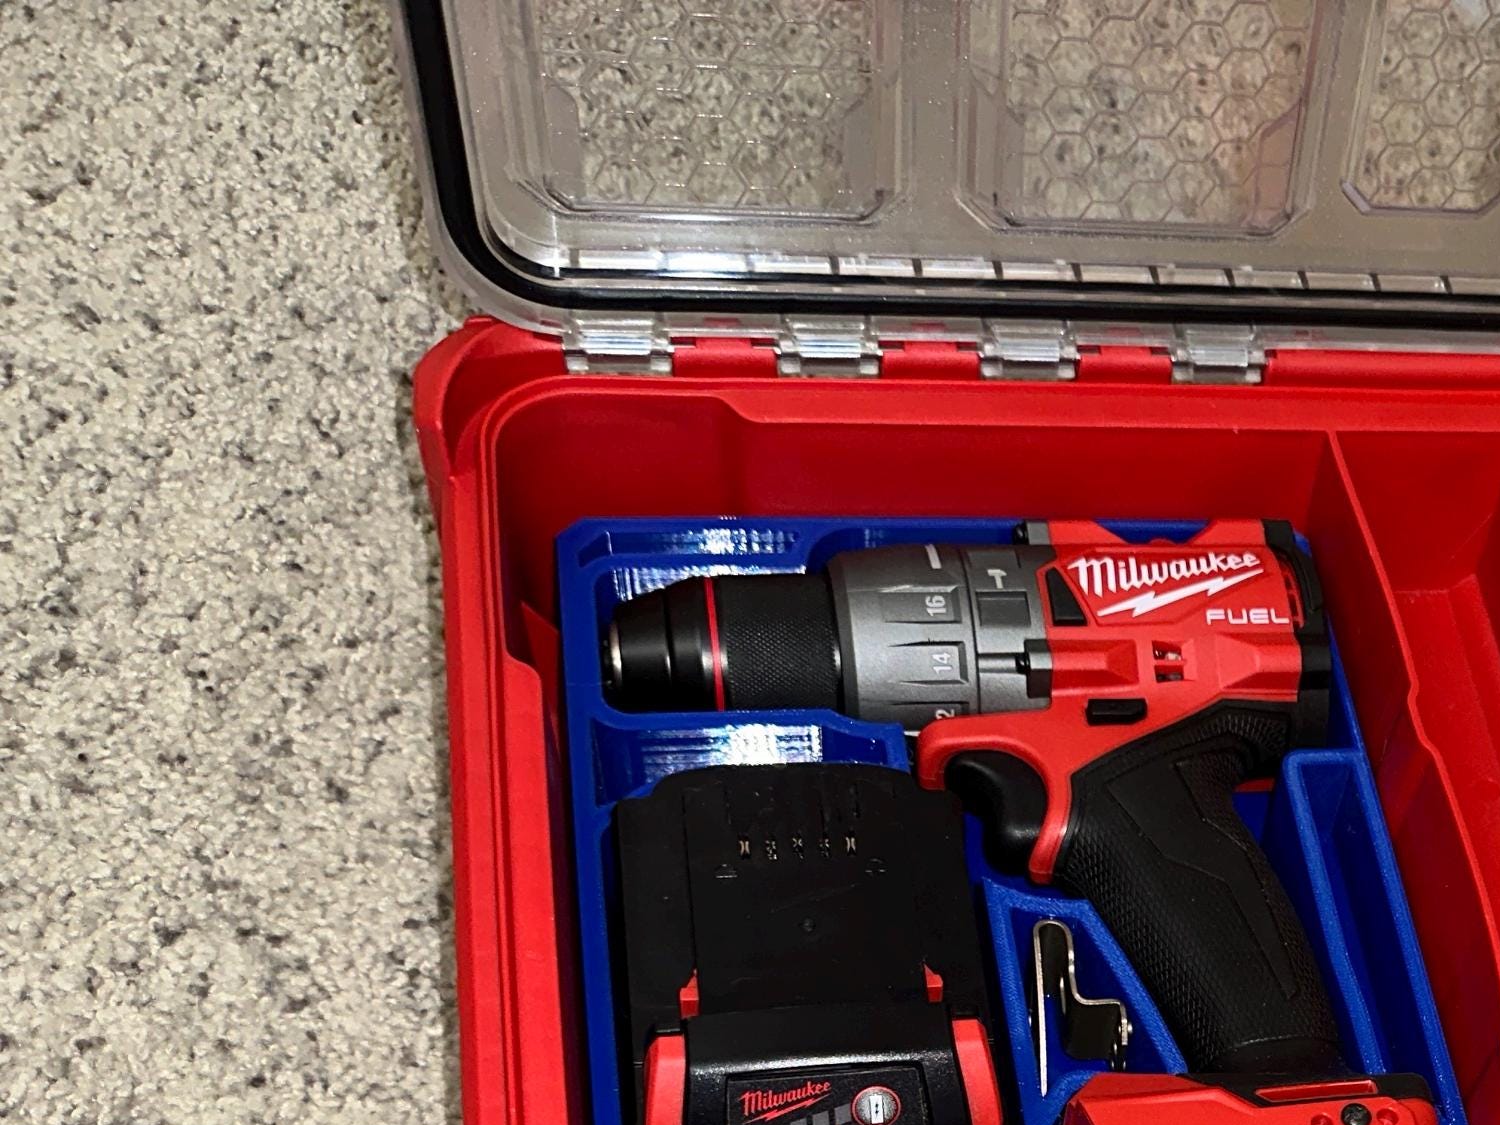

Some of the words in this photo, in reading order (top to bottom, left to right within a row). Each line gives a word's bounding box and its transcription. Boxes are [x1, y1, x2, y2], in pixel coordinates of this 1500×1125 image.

[1068, 552, 1262, 597] Milwaukee
[926, 595, 947, 616] 16
[1205, 608, 1290, 625] FUEL
[932, 652, 953, 673] 14
[936, 708, 956, 720] 2
[739, 1080, 831, 1116] Milwaukee
